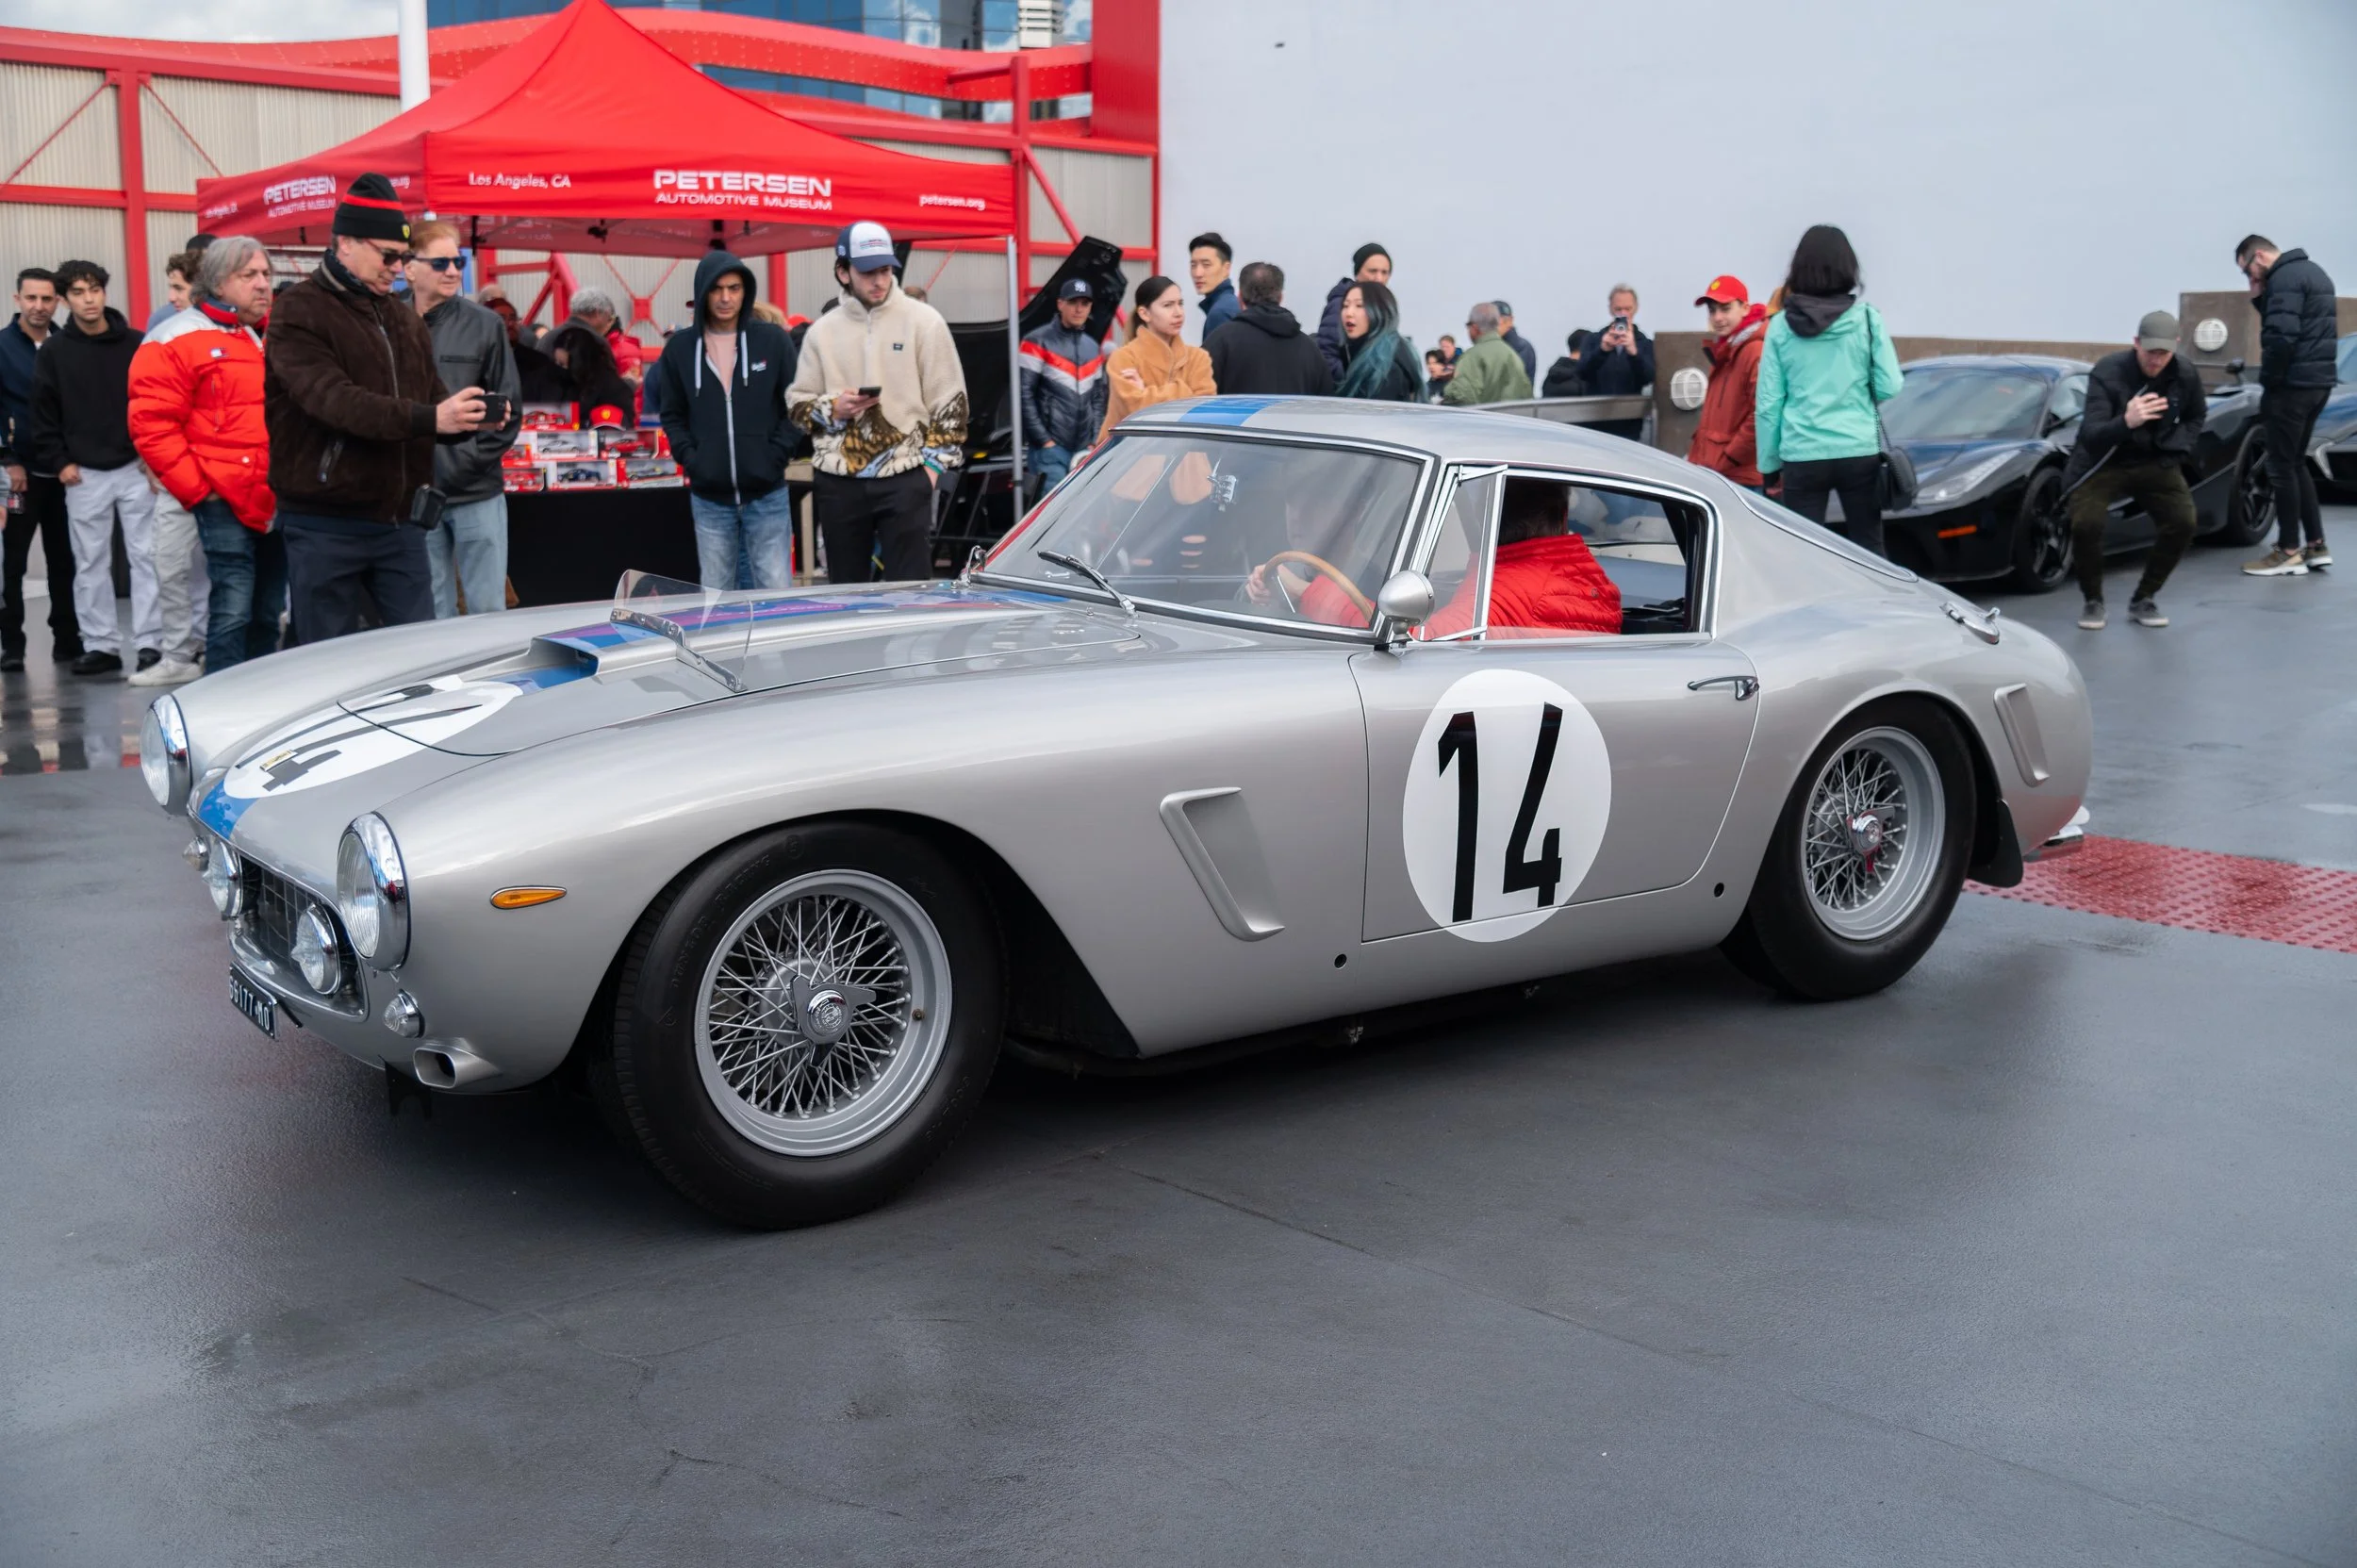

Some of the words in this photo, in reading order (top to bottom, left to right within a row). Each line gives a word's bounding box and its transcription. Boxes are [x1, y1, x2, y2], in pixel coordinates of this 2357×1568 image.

[263, 173, 336, 206] PETERSEN
[469, 172, 491, 186] Los
[493, 173, 549, 190] Angeles,
[551, 173, 571, 188] CA
[653, 169, 832, 197] PETERSEN
[655, 191, 759, 206] AUTOMOTIVE
[764, 196, 833, 210] MUSEUM
[919, 194, 985, 211] petersen.org
[1438, 701, 1563, 923] 14
